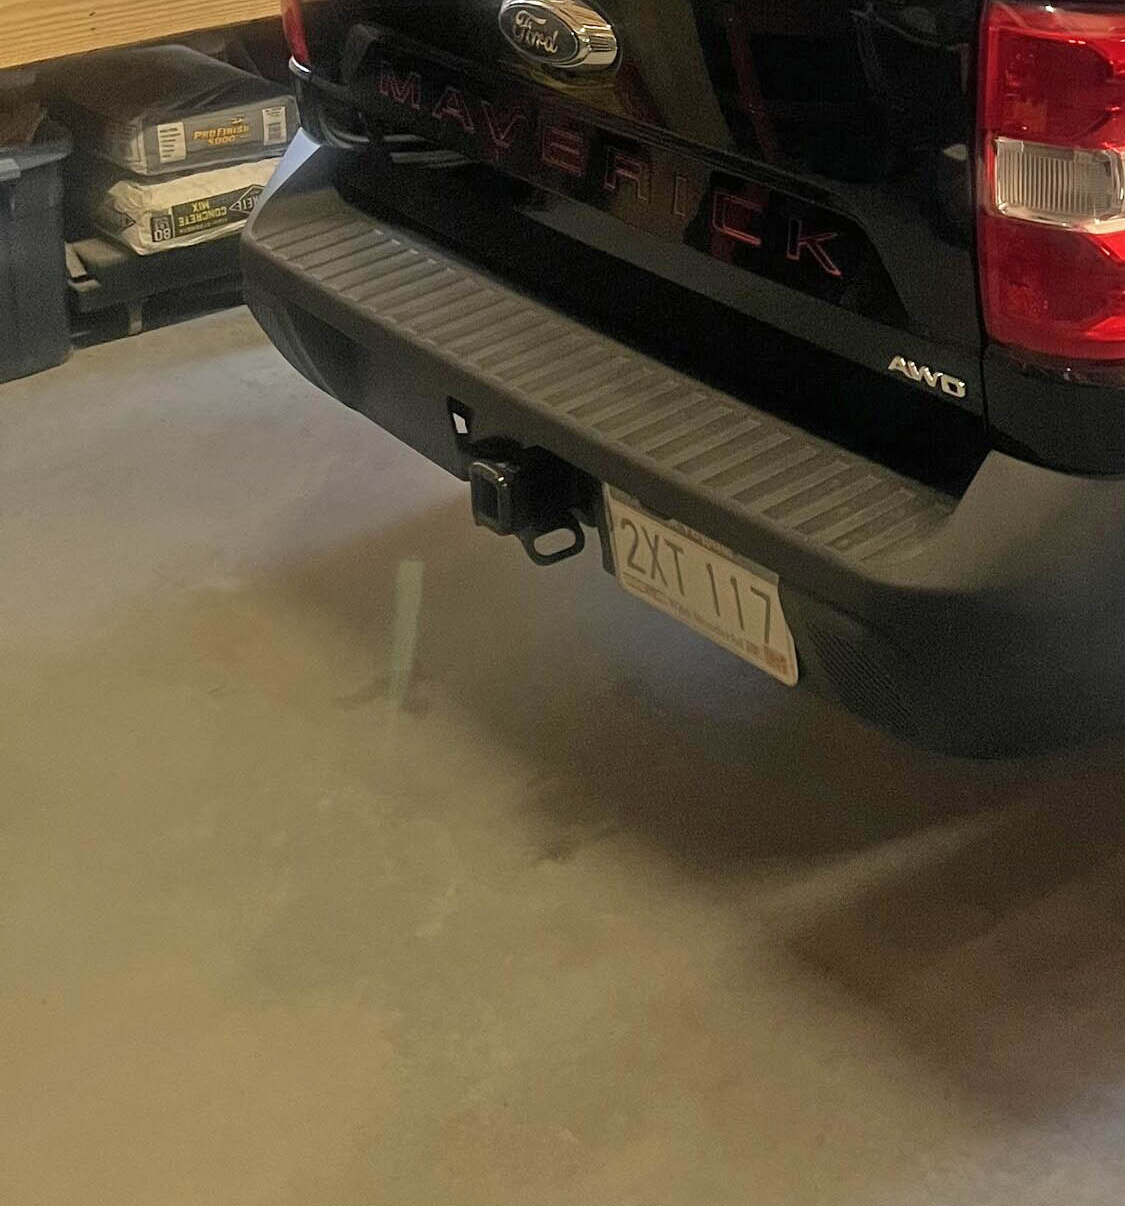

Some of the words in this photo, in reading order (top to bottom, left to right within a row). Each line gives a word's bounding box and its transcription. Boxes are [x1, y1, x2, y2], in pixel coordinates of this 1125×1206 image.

[513, 9, 559, 54] Ford
[375, 71, 843, 278] MAVERICK
[178, 205, 228, 227] CONCRETE
[191, 199, 210, 212] MIX
[153, 227, 172, 242] 80
[888, 355, 966, 398] AWD
[621, 518, 685, 597] 2XT
[705, 562, 771, 644] 117
